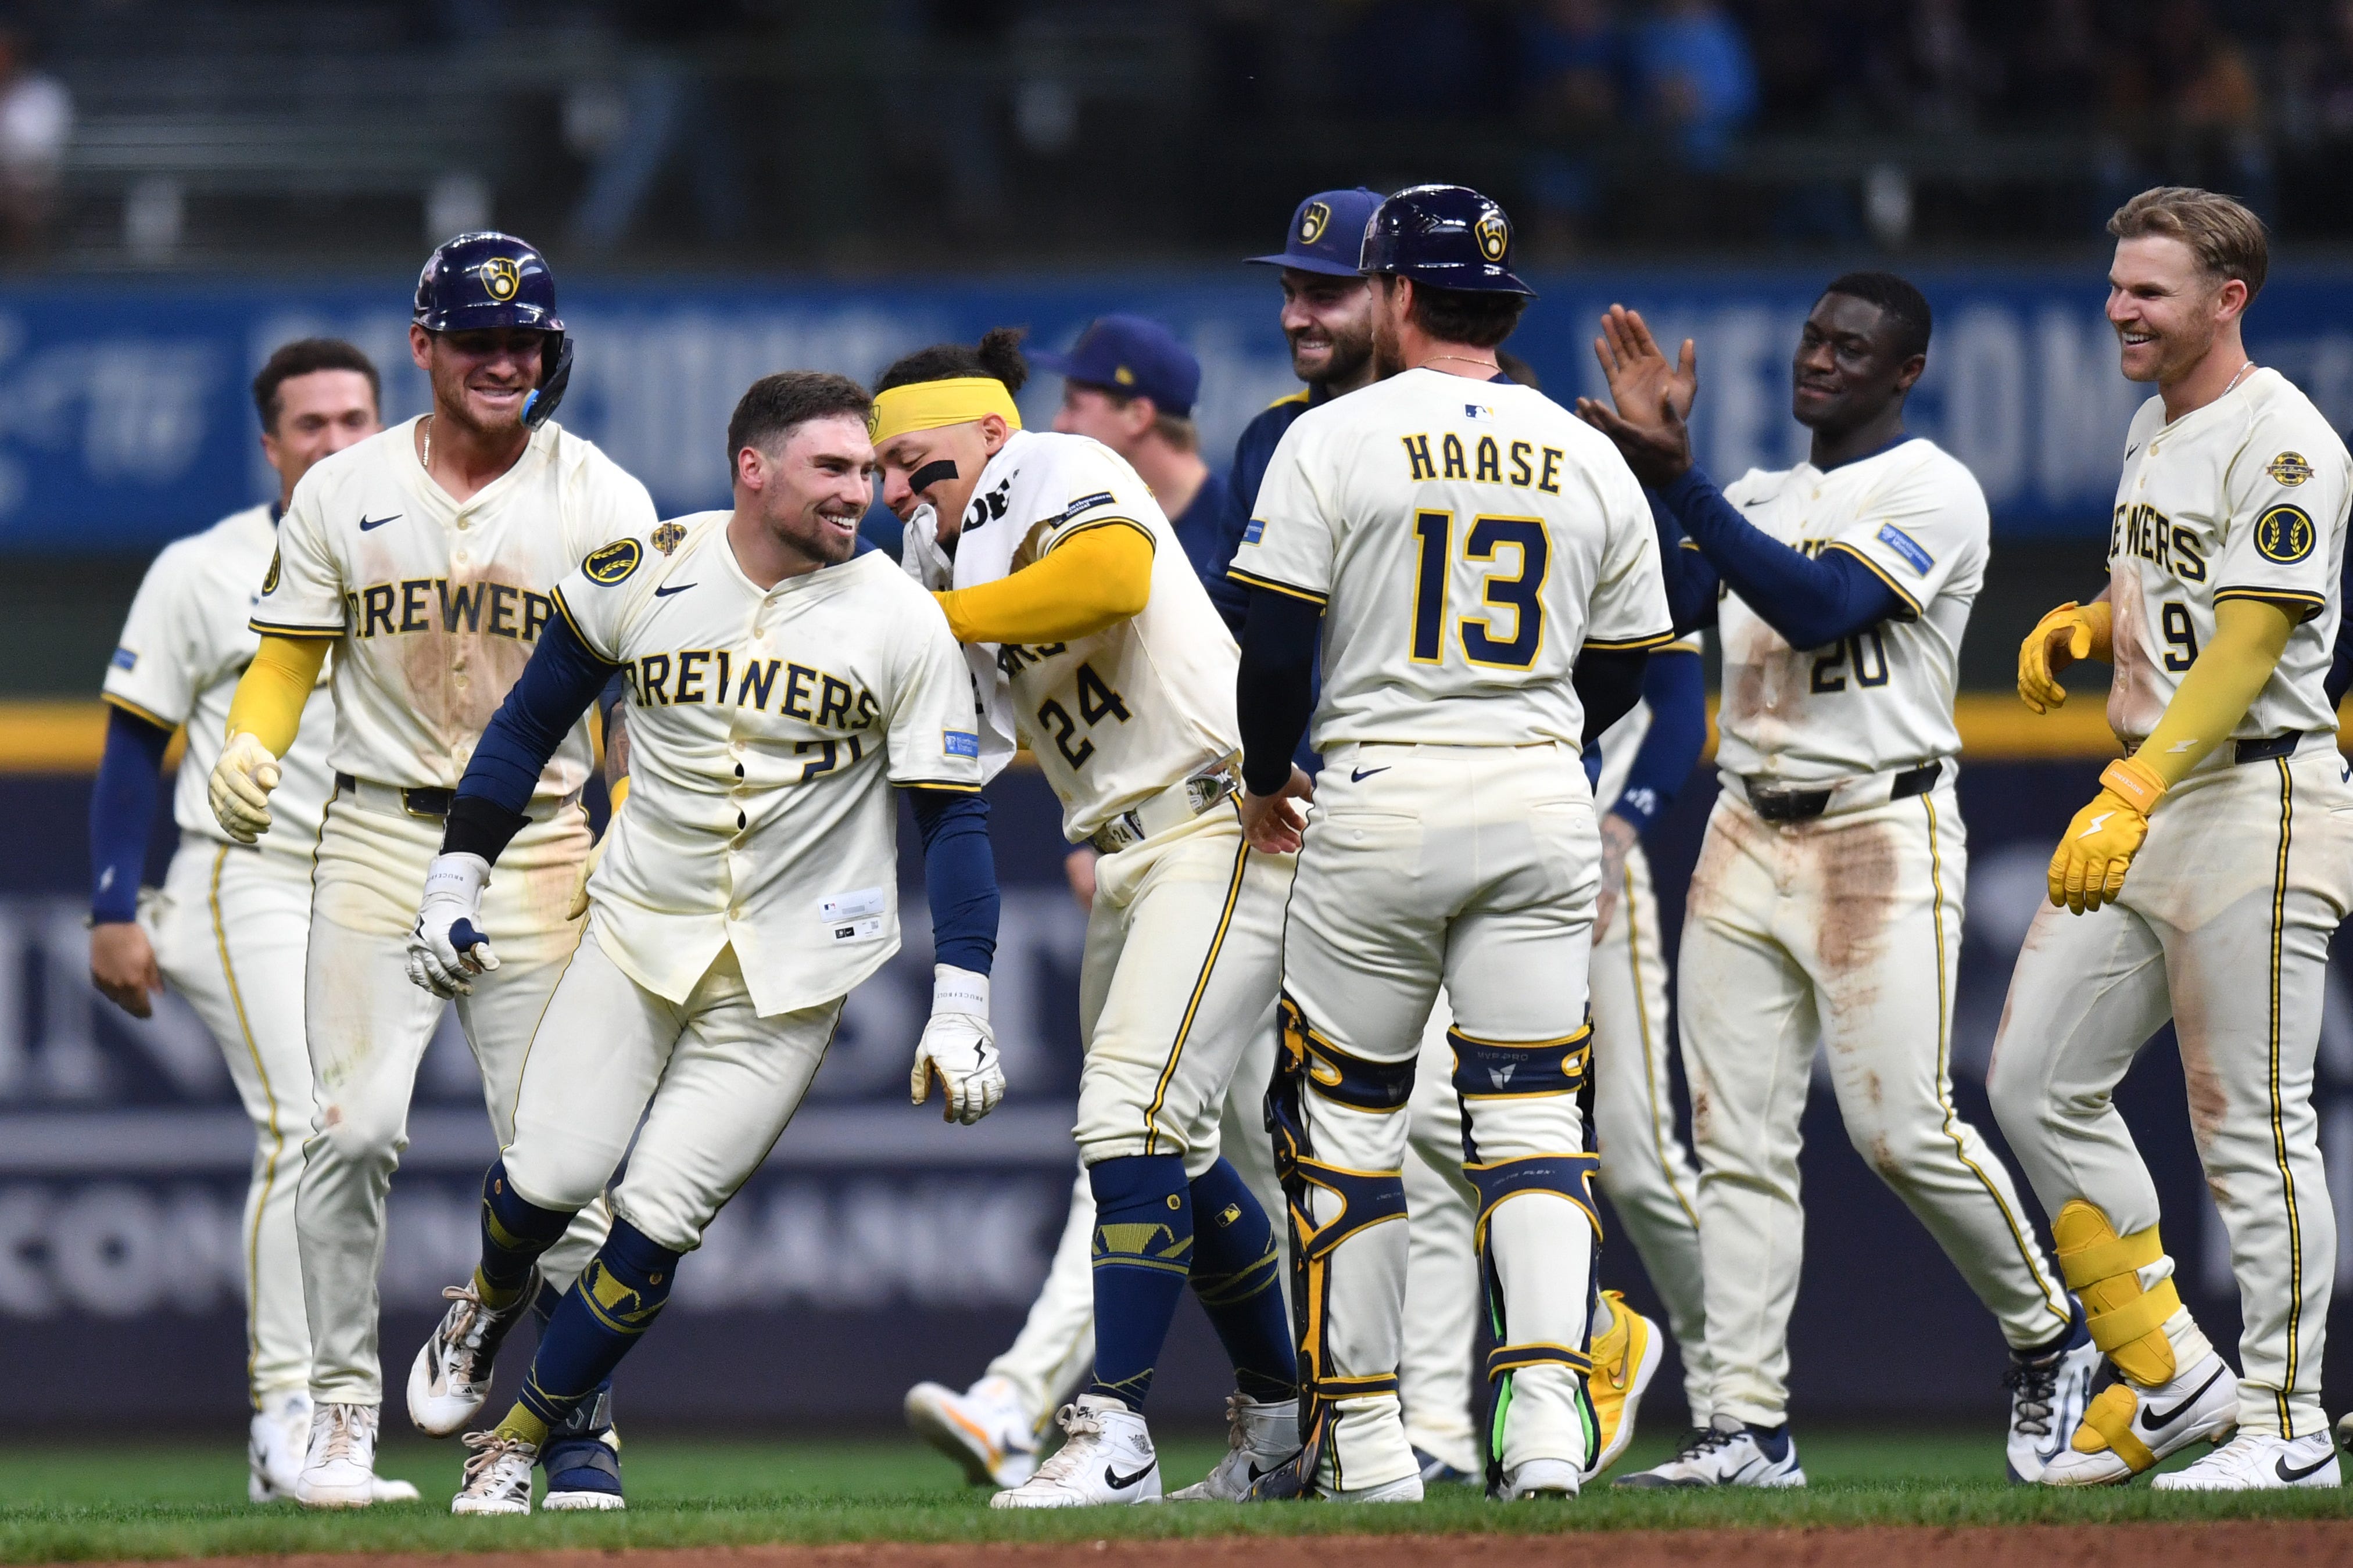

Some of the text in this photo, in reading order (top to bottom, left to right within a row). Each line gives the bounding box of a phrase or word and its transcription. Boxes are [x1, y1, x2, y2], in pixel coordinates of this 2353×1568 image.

[1400, 432, 1565, 496] HAASE
[1068, 494, 1111, 511] orthwestern
[2110, 501, 2208, 585] EWERS
[347, 577, 561, 644] REWER
[1409, 507, 1553, 672] 13
[1810, 625, 1889, 694] 20
[2161, 600, 2200, 673] 9
[1037, 661, 1133, 773] 24
[1112, 826, 1133, 844] 24
